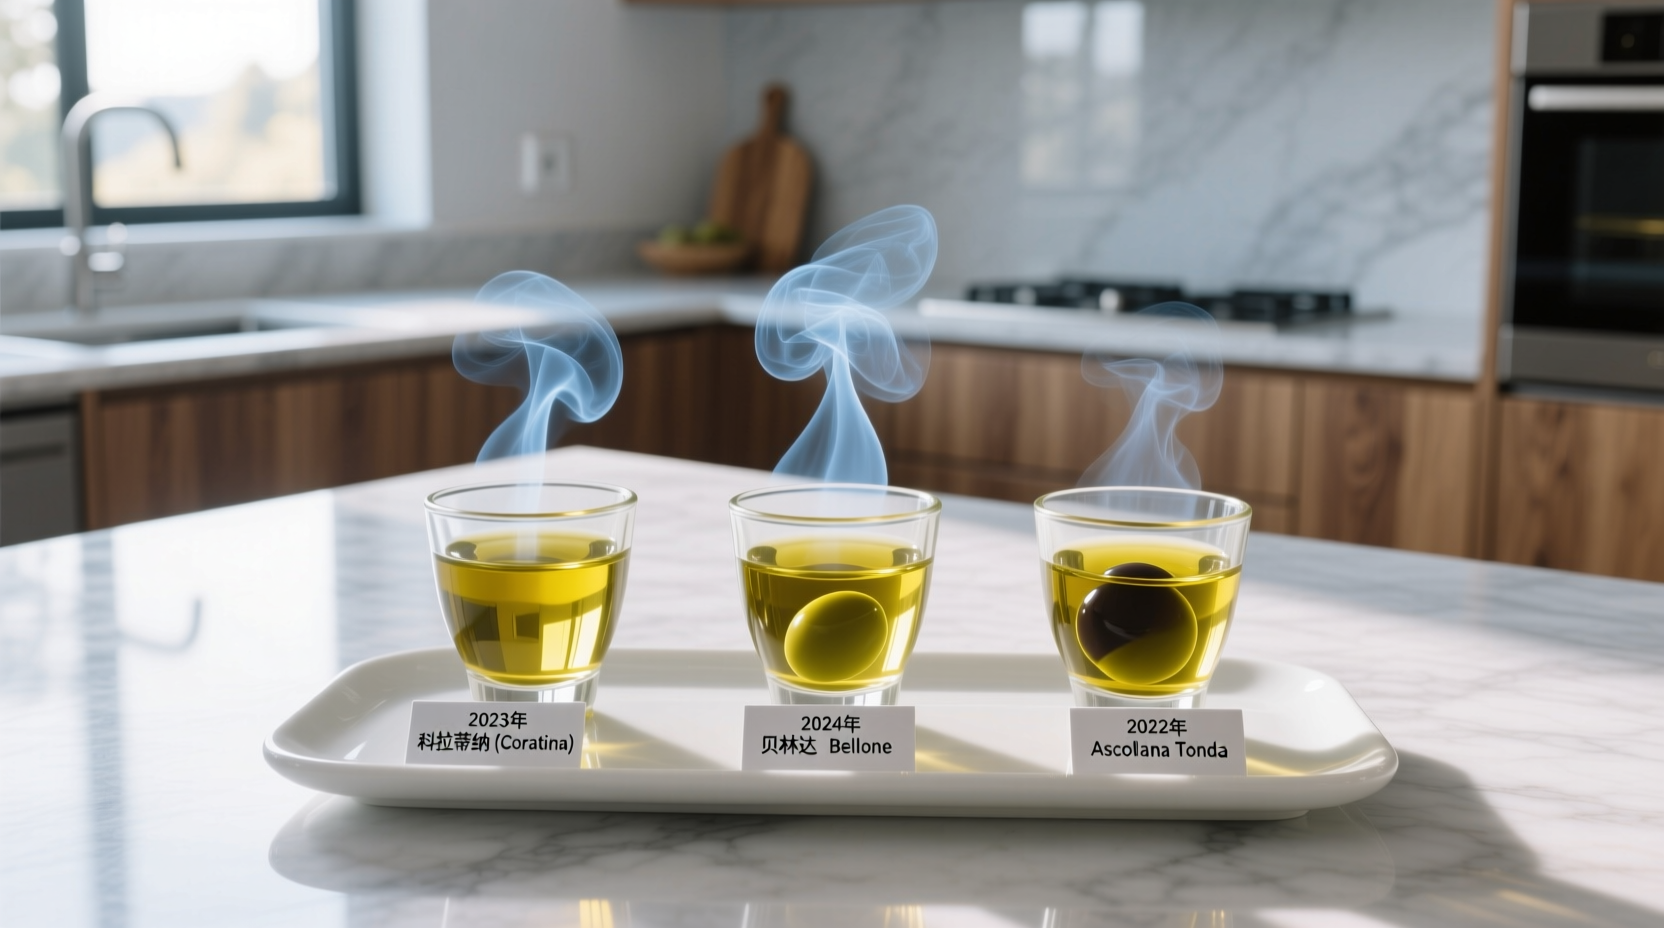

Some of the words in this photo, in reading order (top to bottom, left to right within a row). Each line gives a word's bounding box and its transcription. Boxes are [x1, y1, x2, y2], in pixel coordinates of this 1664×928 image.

[468, 710, 528, 730] 2023年
[801, 714, 861, 734] 2024年
[1126, 718, 1187, 738] 2022年
[495, 733, 574, 755] (Coratina)
[761, 734, 817, 755] 贝林达
[829, 737, 892, 754] Bellone
[1175, 741, 1228, 758] Tonda
